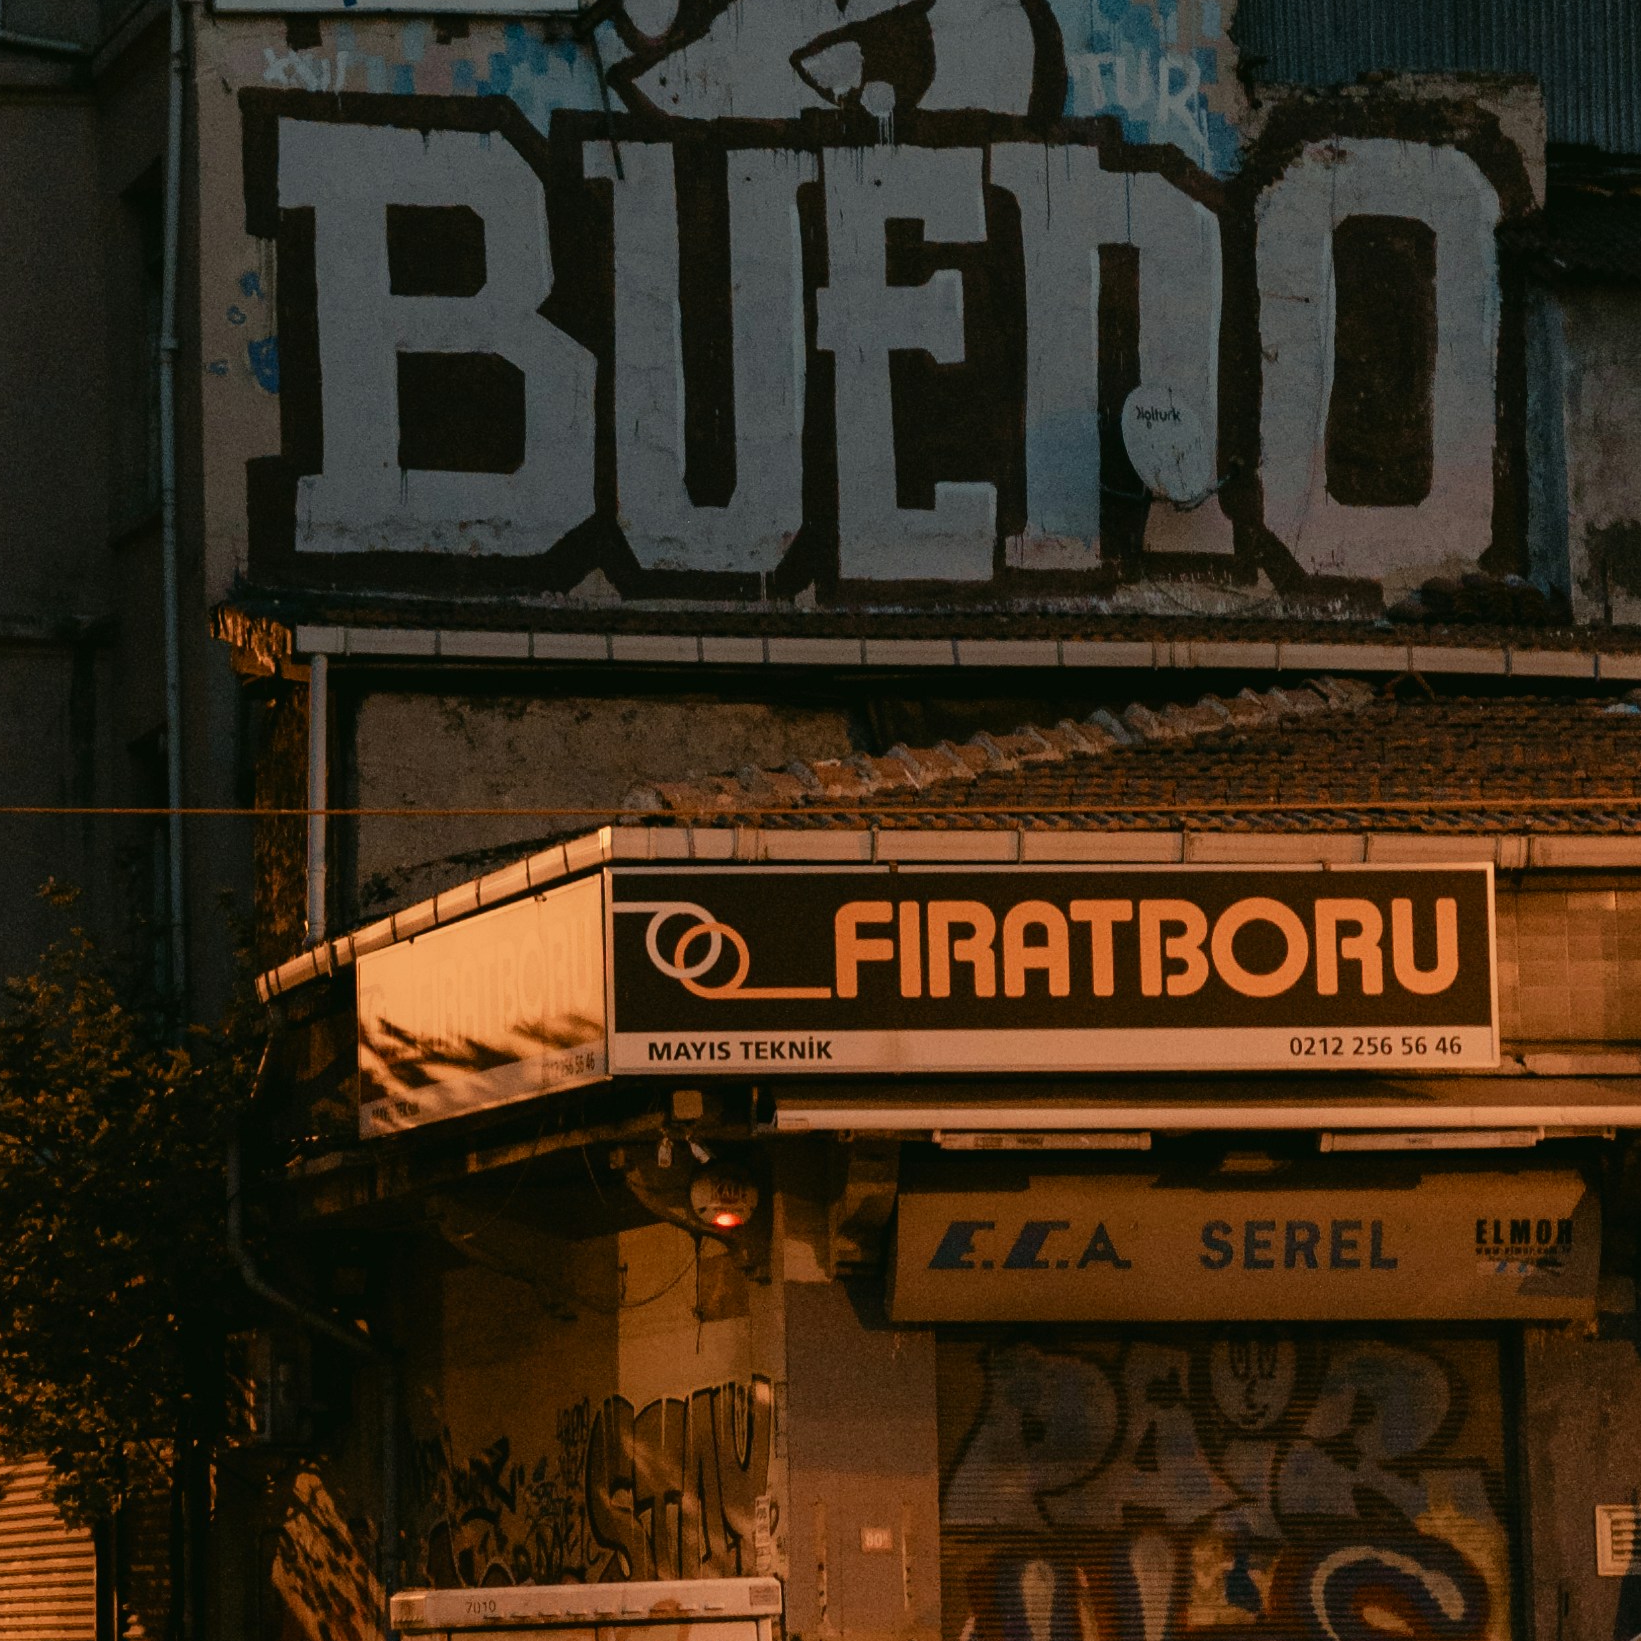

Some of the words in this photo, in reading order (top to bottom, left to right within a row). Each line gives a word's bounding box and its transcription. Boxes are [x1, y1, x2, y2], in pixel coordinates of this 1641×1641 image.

[833, 896, 1460, 999] FIRATBORU
[647, 1040, 731, 1061] MAYIS
[1289, 1036, 1344, 1057] 0212
[1353, 1036, 1393, 1056] 256
[1400, 1036, 1428, 1056] 56
[1434, 1035, 1463, 1056] 46
[1198, 1219, 1399, 1270] SEREL
